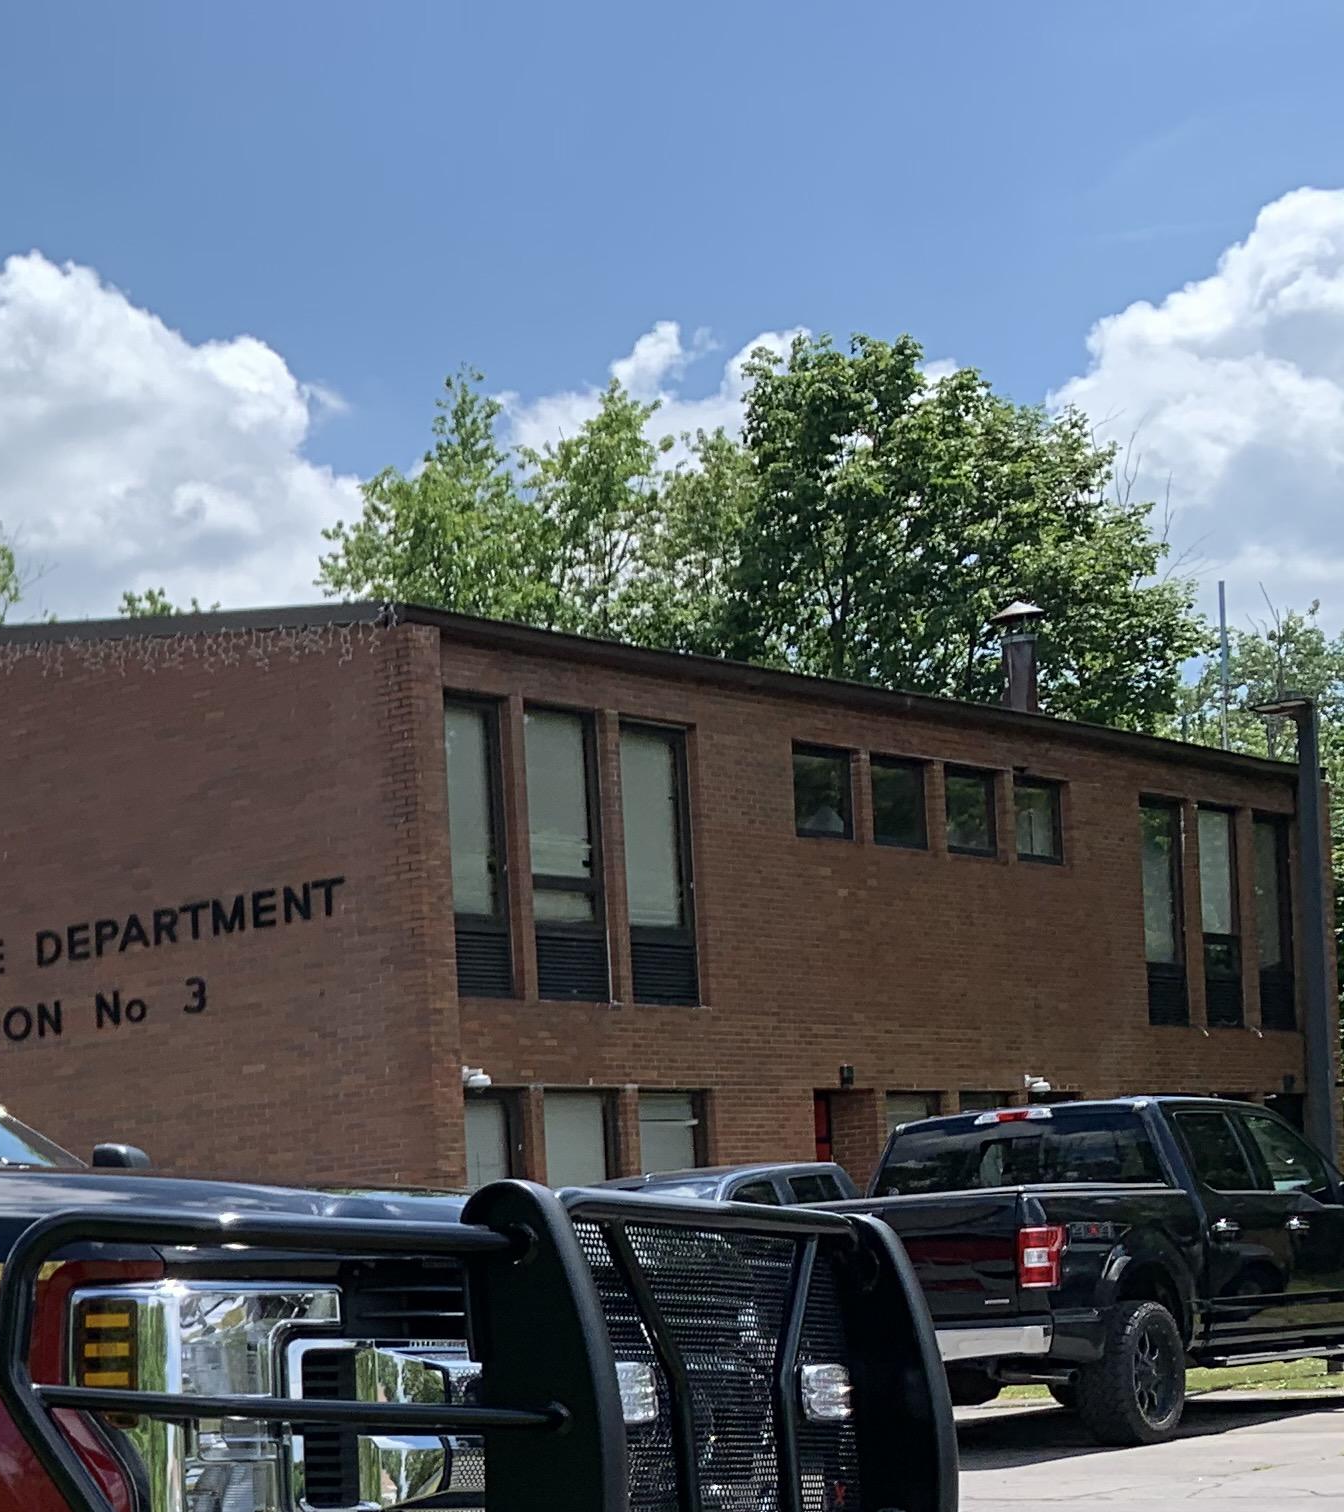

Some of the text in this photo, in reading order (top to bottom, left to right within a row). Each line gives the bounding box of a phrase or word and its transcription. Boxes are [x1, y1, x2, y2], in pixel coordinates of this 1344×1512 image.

[35, 876, 346, 968] DEPARTMENT
[95, 992, 148, 1029] No
[183, 977, 208, 1015] 3
